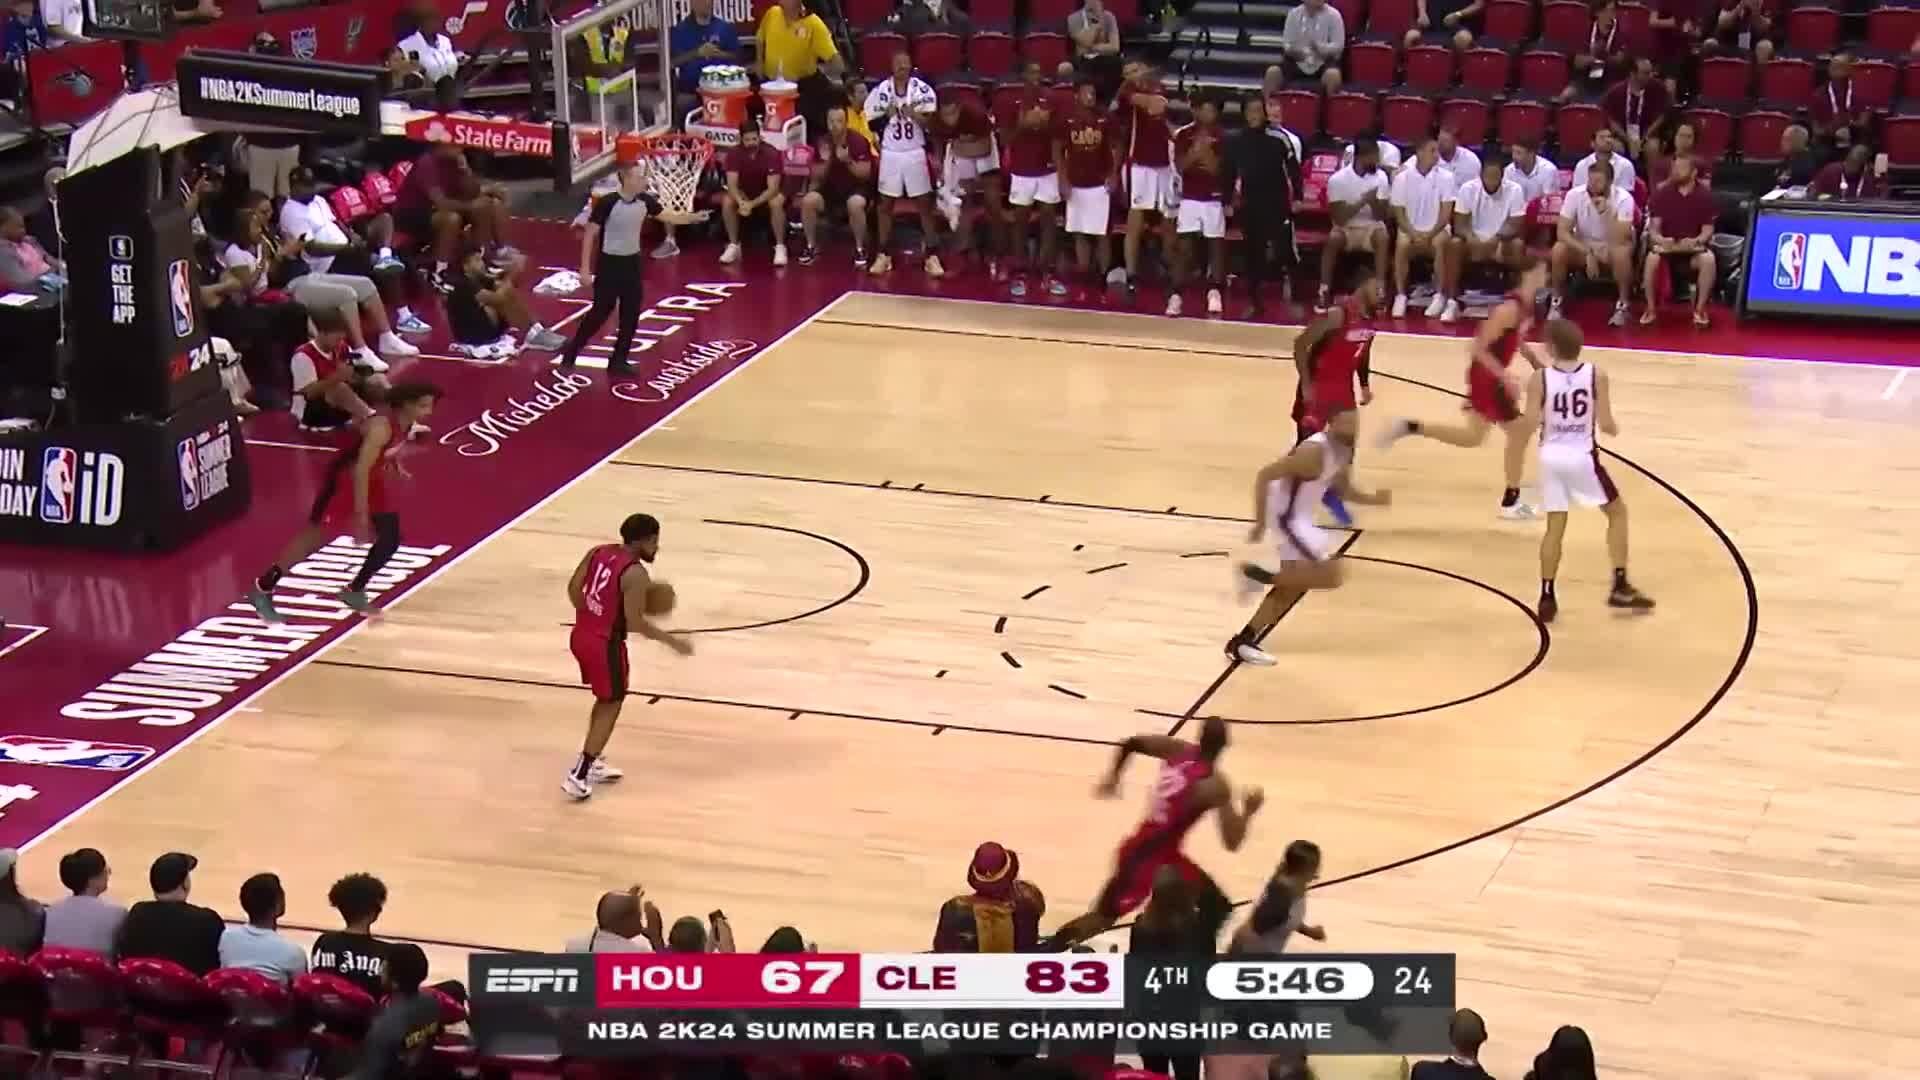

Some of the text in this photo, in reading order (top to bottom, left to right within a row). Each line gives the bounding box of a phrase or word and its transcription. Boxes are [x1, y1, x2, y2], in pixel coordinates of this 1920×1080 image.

[200, 76, 360, 117] #NBA2KSummerLeague
[893, 122, 914, 140] 38
[111, 264, 132, 283] GET
[112, 285, 134, 304] THE
[113, 304, 135, 324] APP
[612, 338, 757, 402] Courtside
[440, 369, 592, 456] Michelob
[1553, 388, 1588, 419] 46
[0, 448, 24, 481] IN
[80, 452, 124, 526] iD
[591, 562, 612, 601] 12
[60, 616, 332, 727] SUMMER
